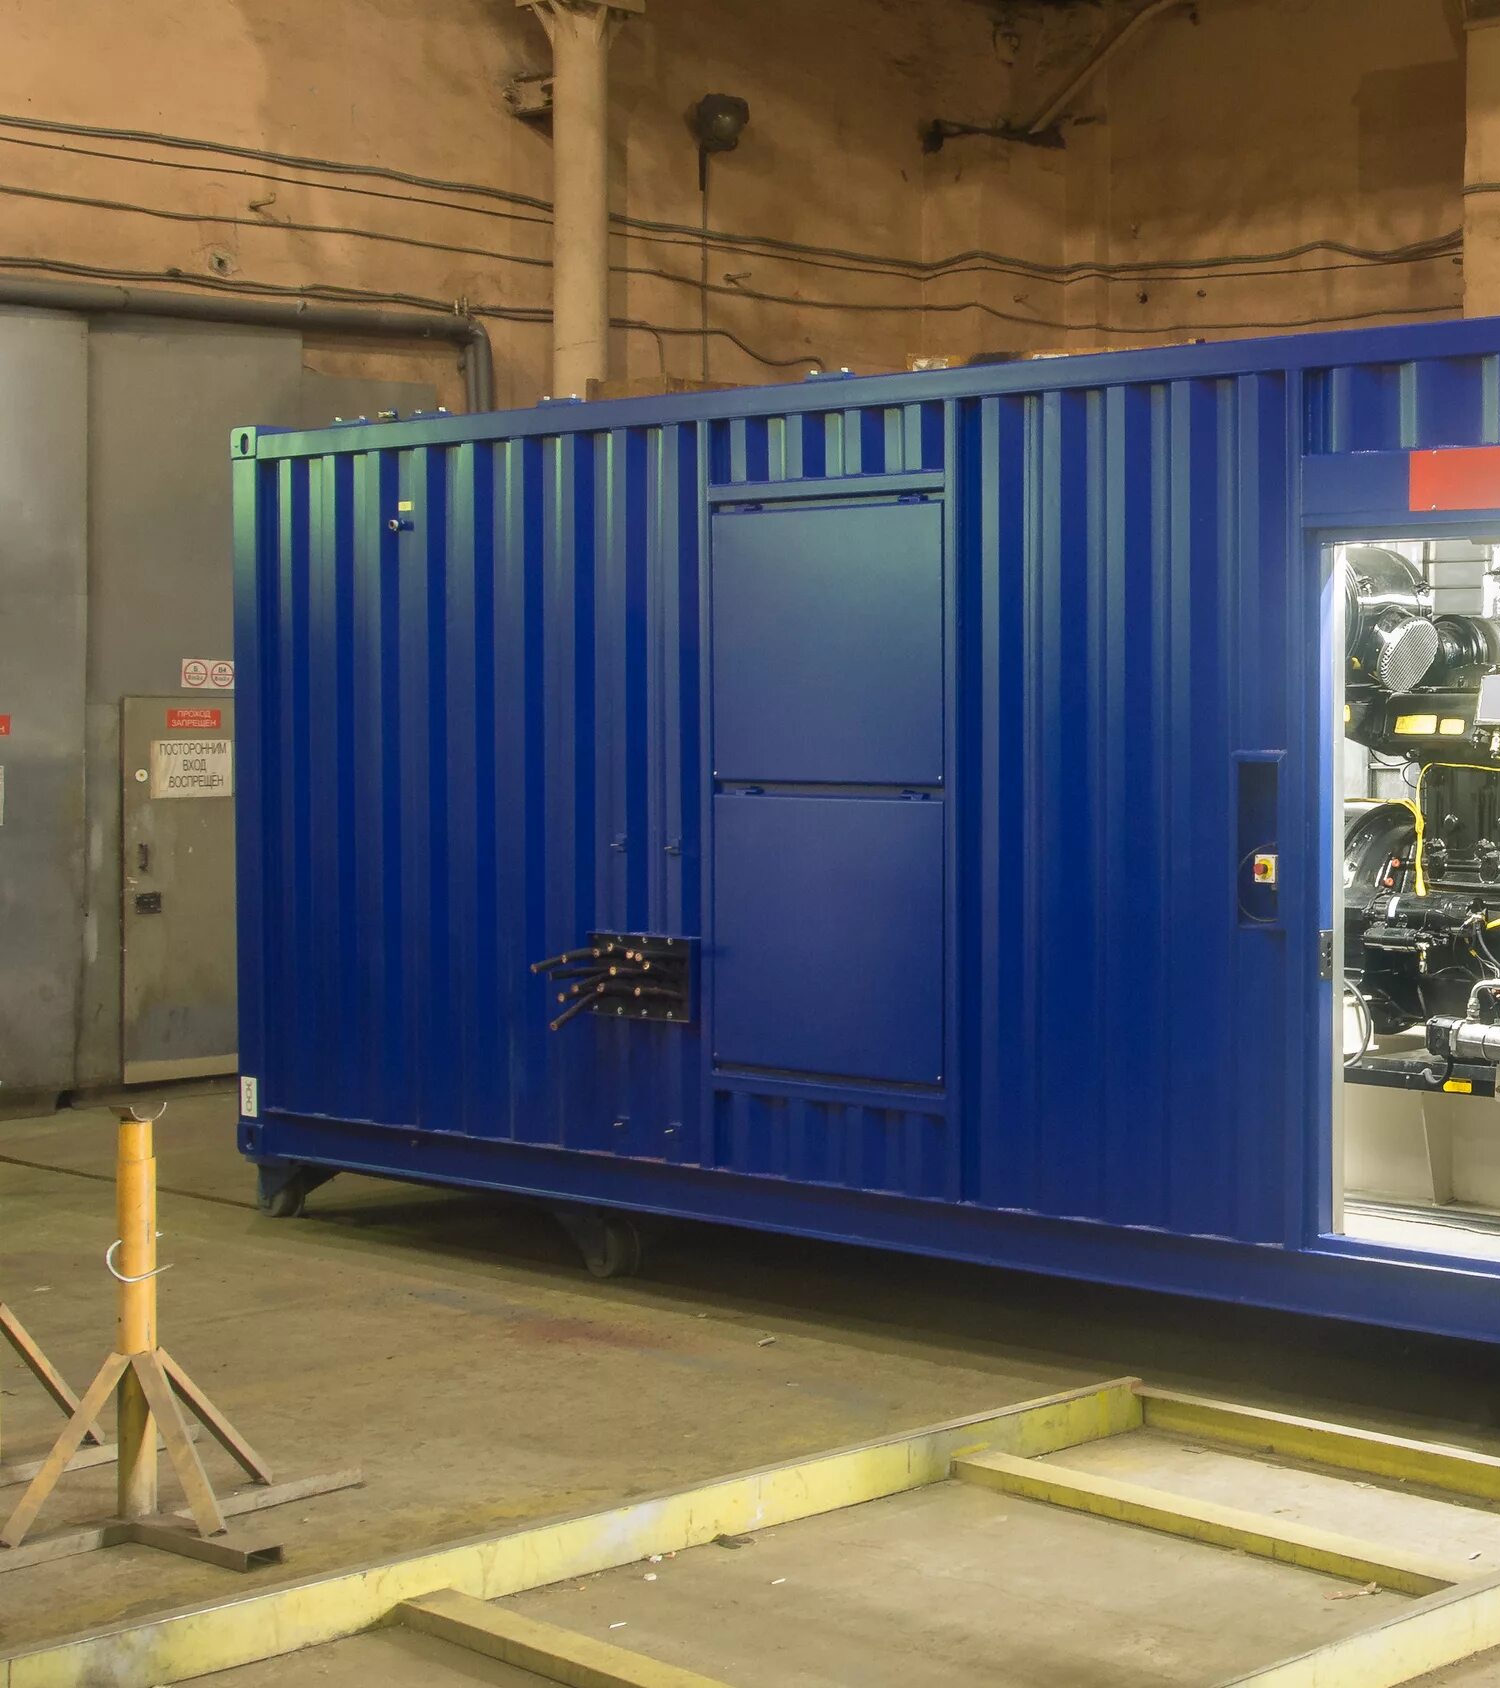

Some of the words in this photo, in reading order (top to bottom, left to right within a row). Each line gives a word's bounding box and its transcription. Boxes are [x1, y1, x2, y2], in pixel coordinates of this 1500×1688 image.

[177, 710, 211, 718] ПРОХОД
[159, 743, 227, 756] ПОСТОРОННИМ
[182, 759, 207, 773] ВХОД
